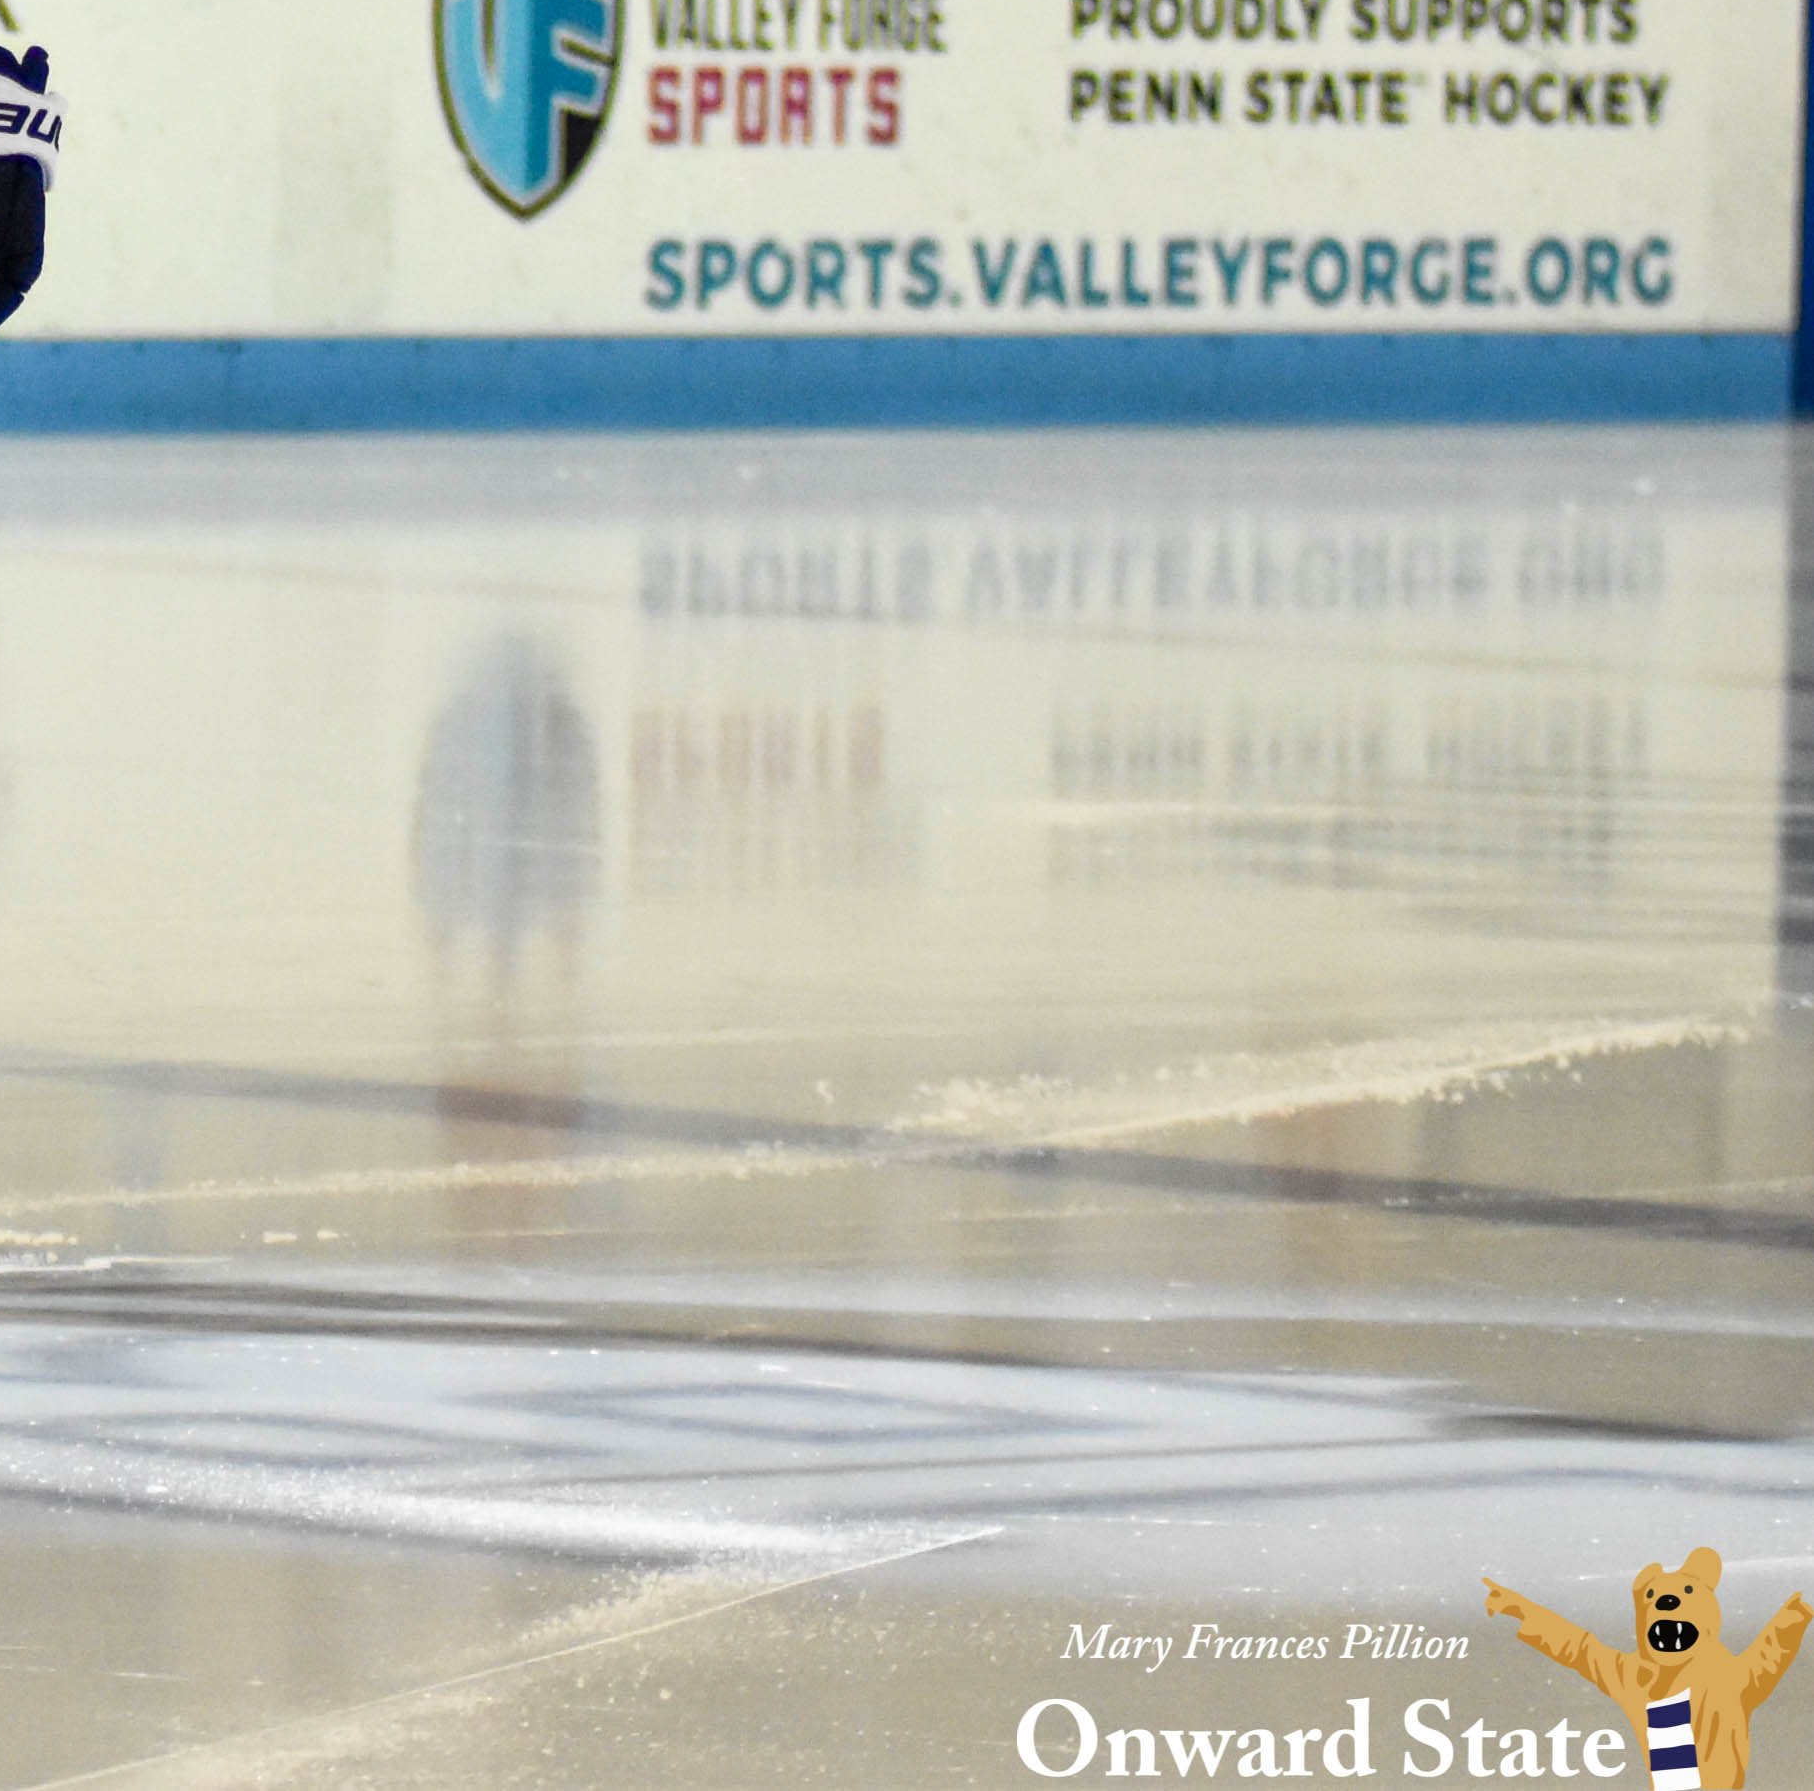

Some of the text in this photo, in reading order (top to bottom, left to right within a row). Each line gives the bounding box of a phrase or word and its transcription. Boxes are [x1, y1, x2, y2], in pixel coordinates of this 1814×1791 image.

[646, 67, 902, 146] SPORTS
[1070, 69, 1222, 124] PENN
[1444, 72, 1671, 126] HOCKEY
[644, 235, 1676, 311] SPORTS.VALLEYFORGE.ORG
